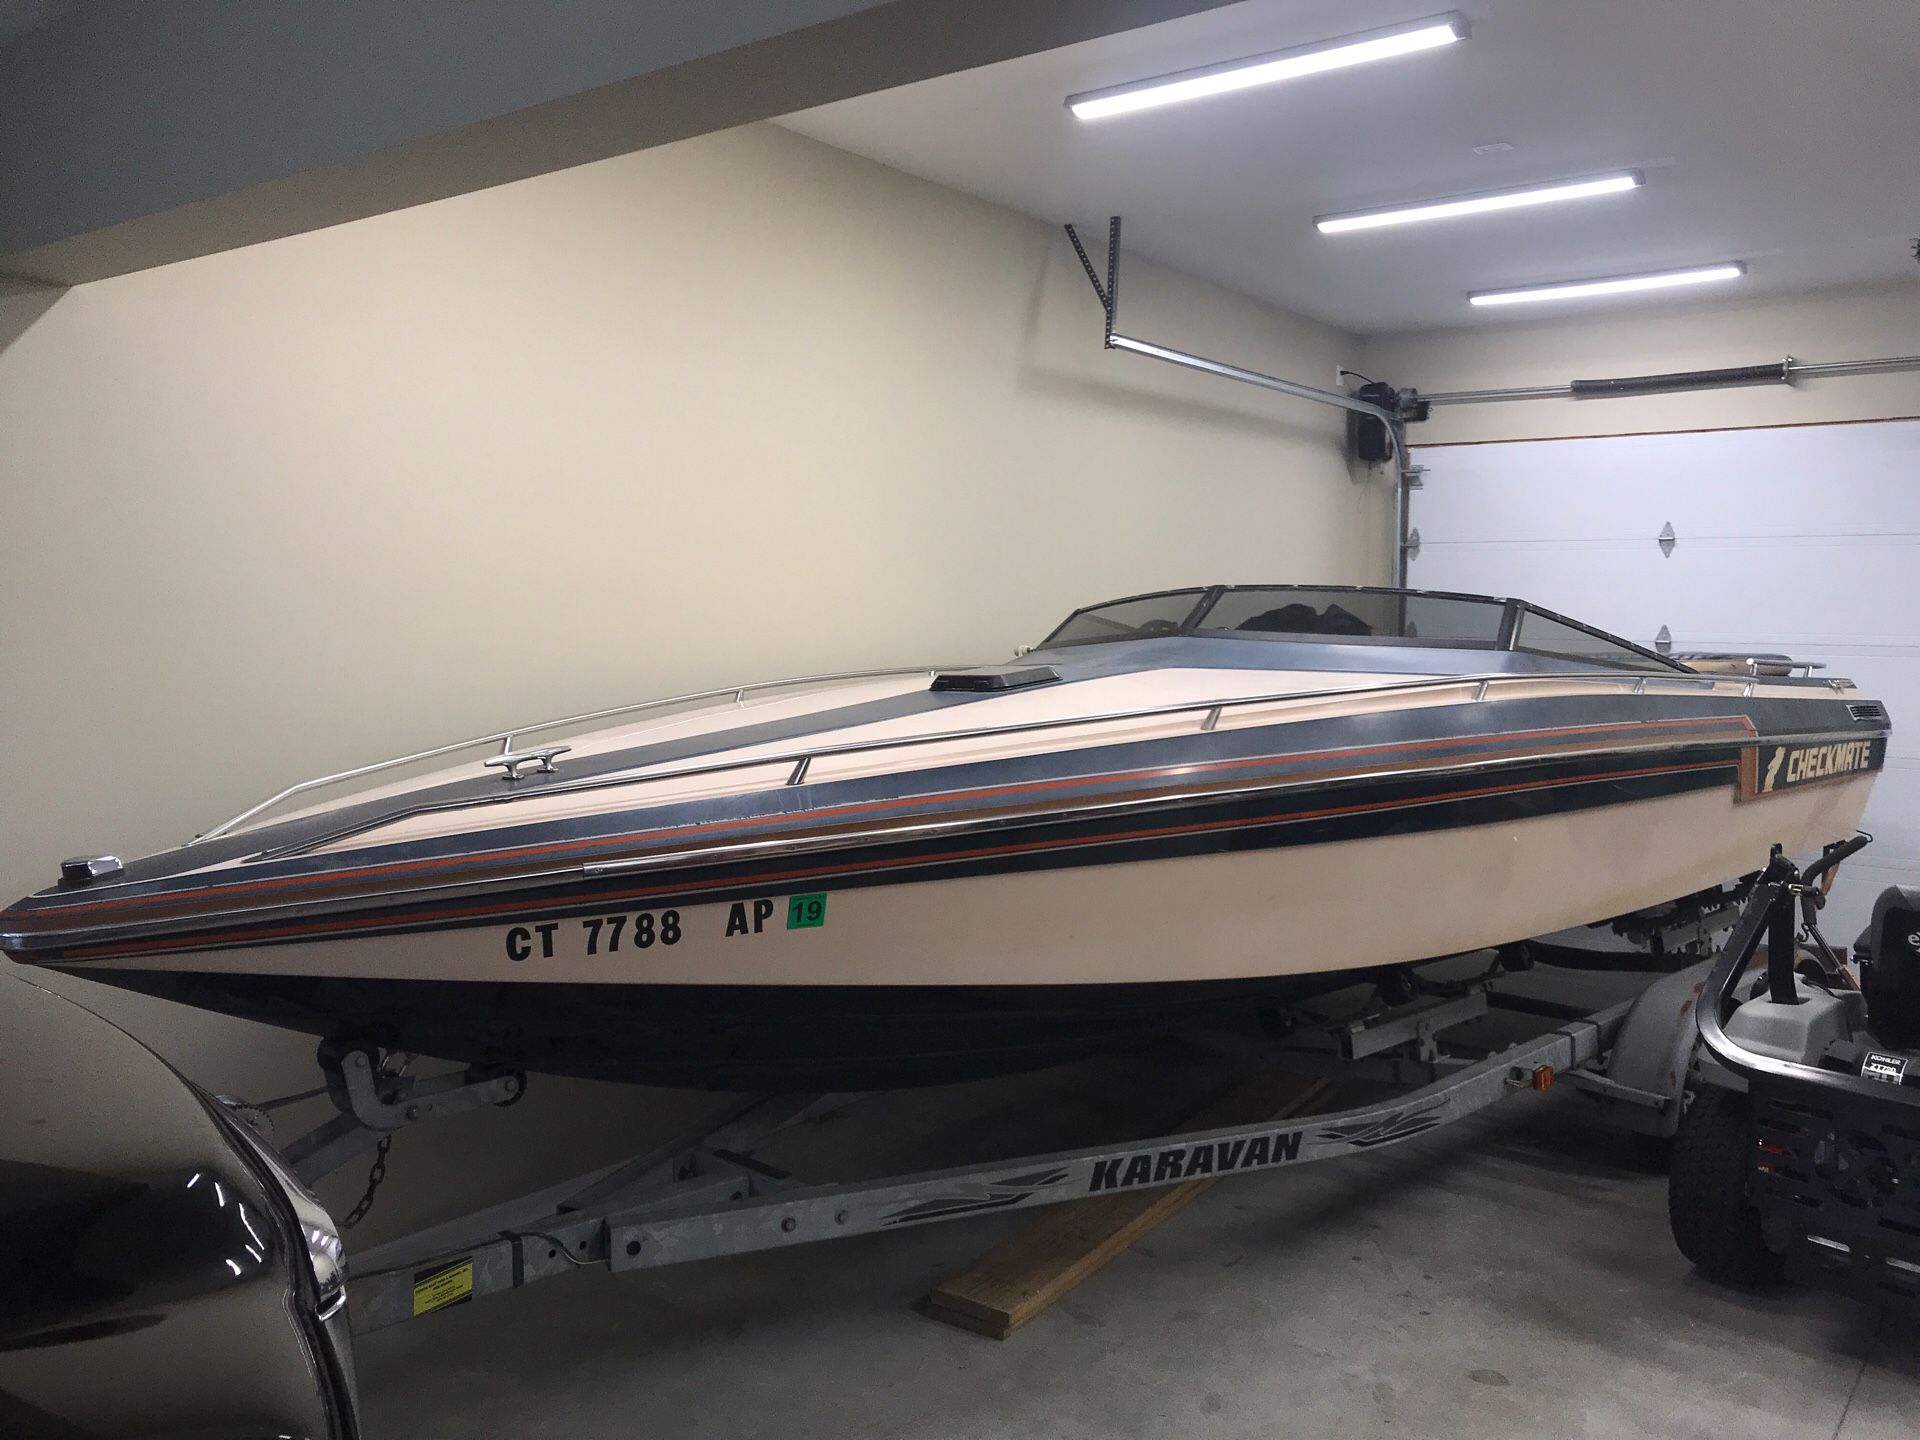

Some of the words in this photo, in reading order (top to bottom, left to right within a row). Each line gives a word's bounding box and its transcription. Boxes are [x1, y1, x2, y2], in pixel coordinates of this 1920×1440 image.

[1786, 741, 1871, 783] CHECKMATE
[506, 923, 559, 961] CT
[582, 910, 682, 956] 7788
[725, 899, 774, 937] AP
[792, 900, 823, 923] 19
[1870, 1054, 1902, 1066] KOHLER
[1089, 1131, 1303, 1192] KARAVAN
